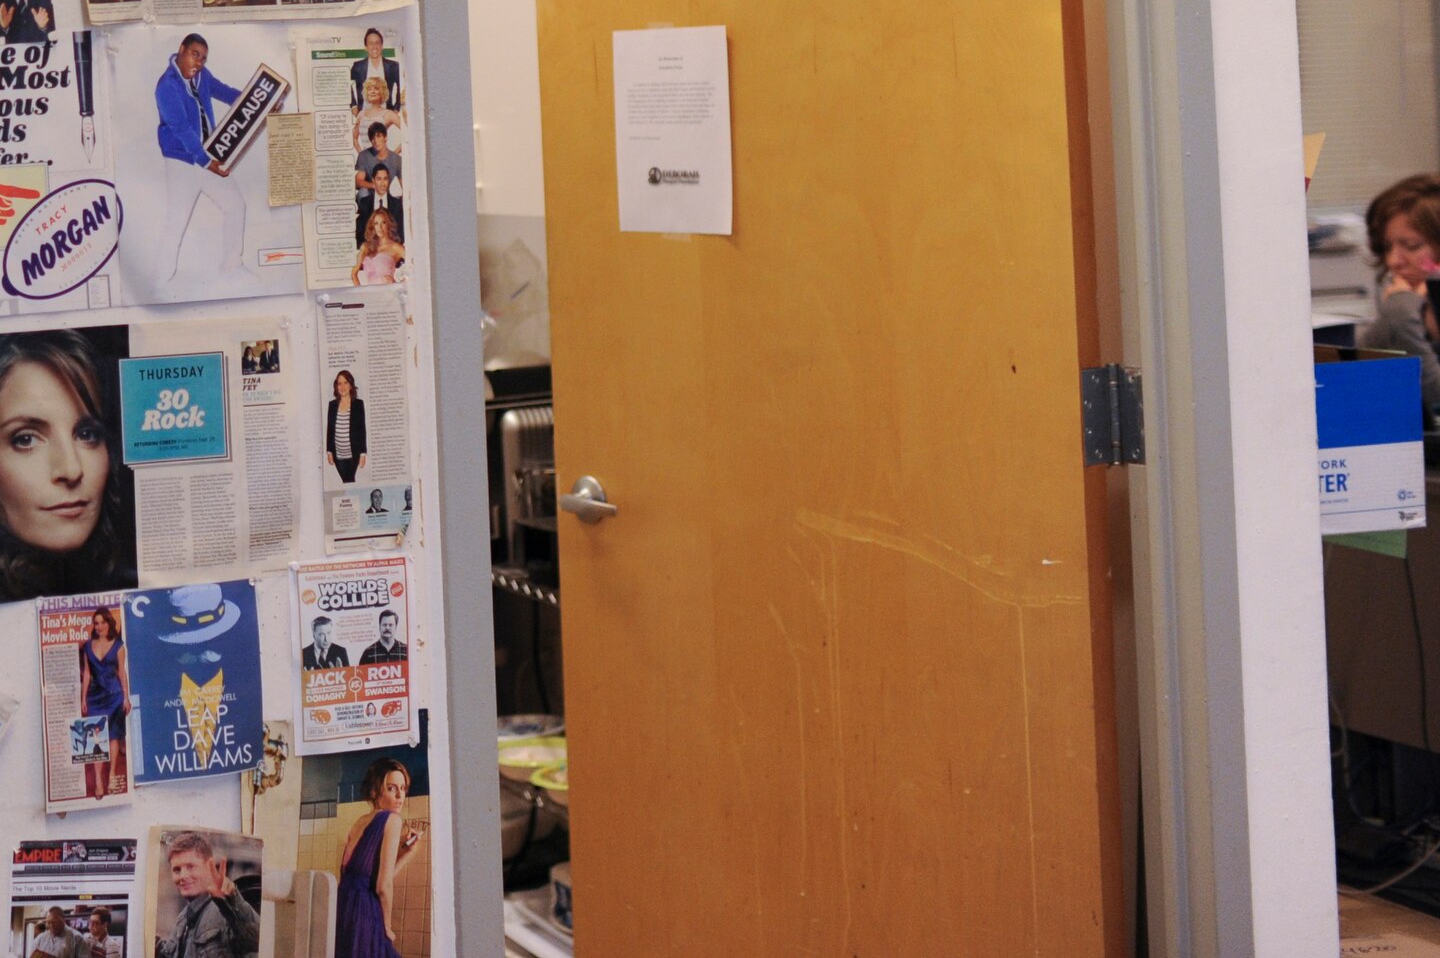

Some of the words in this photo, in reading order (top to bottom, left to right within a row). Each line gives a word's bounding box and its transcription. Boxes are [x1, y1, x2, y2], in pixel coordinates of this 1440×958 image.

[24, 40, 58, 69] of
[213, 76, 275, 159] APPLAUSE
[21, 195, 111, 286] MORGAN
[139, 366, 204, 380] THURSDAY
[157, 389, 189, 410] 30
[142, 405, 205, 431] Rock
[1319, 459, 1347, 469] ORK
[318, 578, 387, 596] WORLDS
[41, 597, 68, 610] THIS
[73, 595, 121, 608] MINUTE
[318, 592, 390, 611] COLLIDE
[42, 616, 66, 628] Tina's
[68, 613, 92, 626] Mega
[41, 631, 67, 644] Movie
[69, 628, 88, 641] Role
[306, 671, 346, 687] JACK
[367, 666, 402, 680] RON
[305, 693, 346, 703] DONAGHY
[364, 686, 406, 696] SWANSON
[176, 704, 229, 729] LEAP
[173, 725, 235, 751] DAVE
[154, 744, 253, 775] WILLIAMS
[15, 849, 62, 863] EMPIRE
